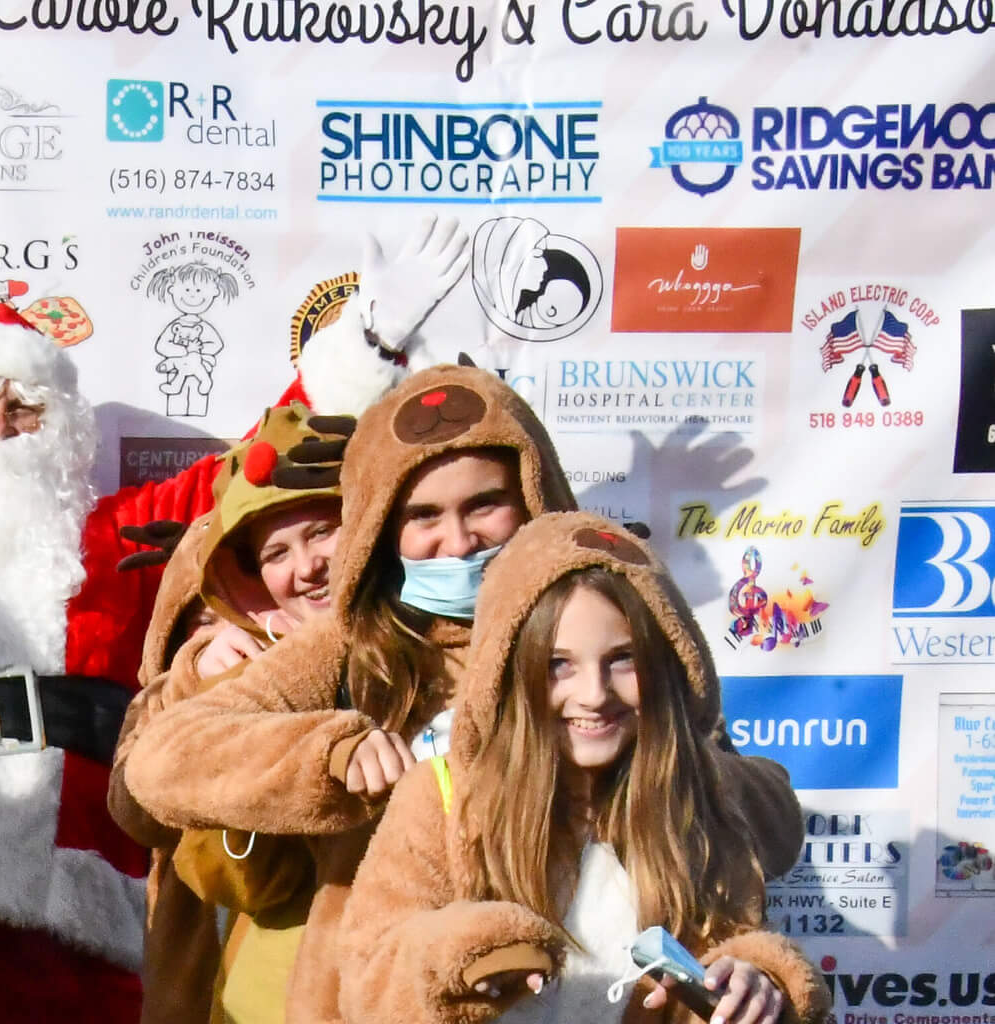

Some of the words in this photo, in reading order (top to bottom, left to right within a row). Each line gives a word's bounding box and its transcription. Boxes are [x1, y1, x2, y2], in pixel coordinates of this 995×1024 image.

[562, 0, 708, 44] Cara
[186, 115, 276, 147] dental
[320, 112, 600, 162] SHINBONE
[752, 102, 995, 151] RIDGEWOO
[109, 168, 166, 194] (516)
[173, 169, 276, 191] 874-7834
[320, 162, 598, 193] PHOTOGRAPHY
[751, 153, 924, 191] SAVINGS
[106, 204, 278, 219] www.randrdental.com
[143, 231, 180, 256] John
[130, 244, 187, 291] Children's
[192, 242, 256, 290] Foundation
[801, 291, 847, 331] ISLAND
[850, 284, 908, 306] ELECTRIC
[909, 298, 941, 328] CORP
[558, 360, 756, 388] BRUNSWICK
[557, 393, 664, 408] HOSPITAL
[671, 393, 755, 408] CENTER
[557, 415, 612, 424] INPATIENT
[616, 415, 680, 424] BEHAVIORAL
[684, 415, 754, 424] HEALTHCARE
[678, 504, 717, 538] The
[726, 505, 803, 538] Marino
[813, 503, 884, 547] Family
[731, 717, 868, 747] sunrun
[788, 868, 839, 885] Service
[841, 869, 886, 885] Salon
[839, 895, 877, 909] Suite
[882, 895, 892, 908] E
